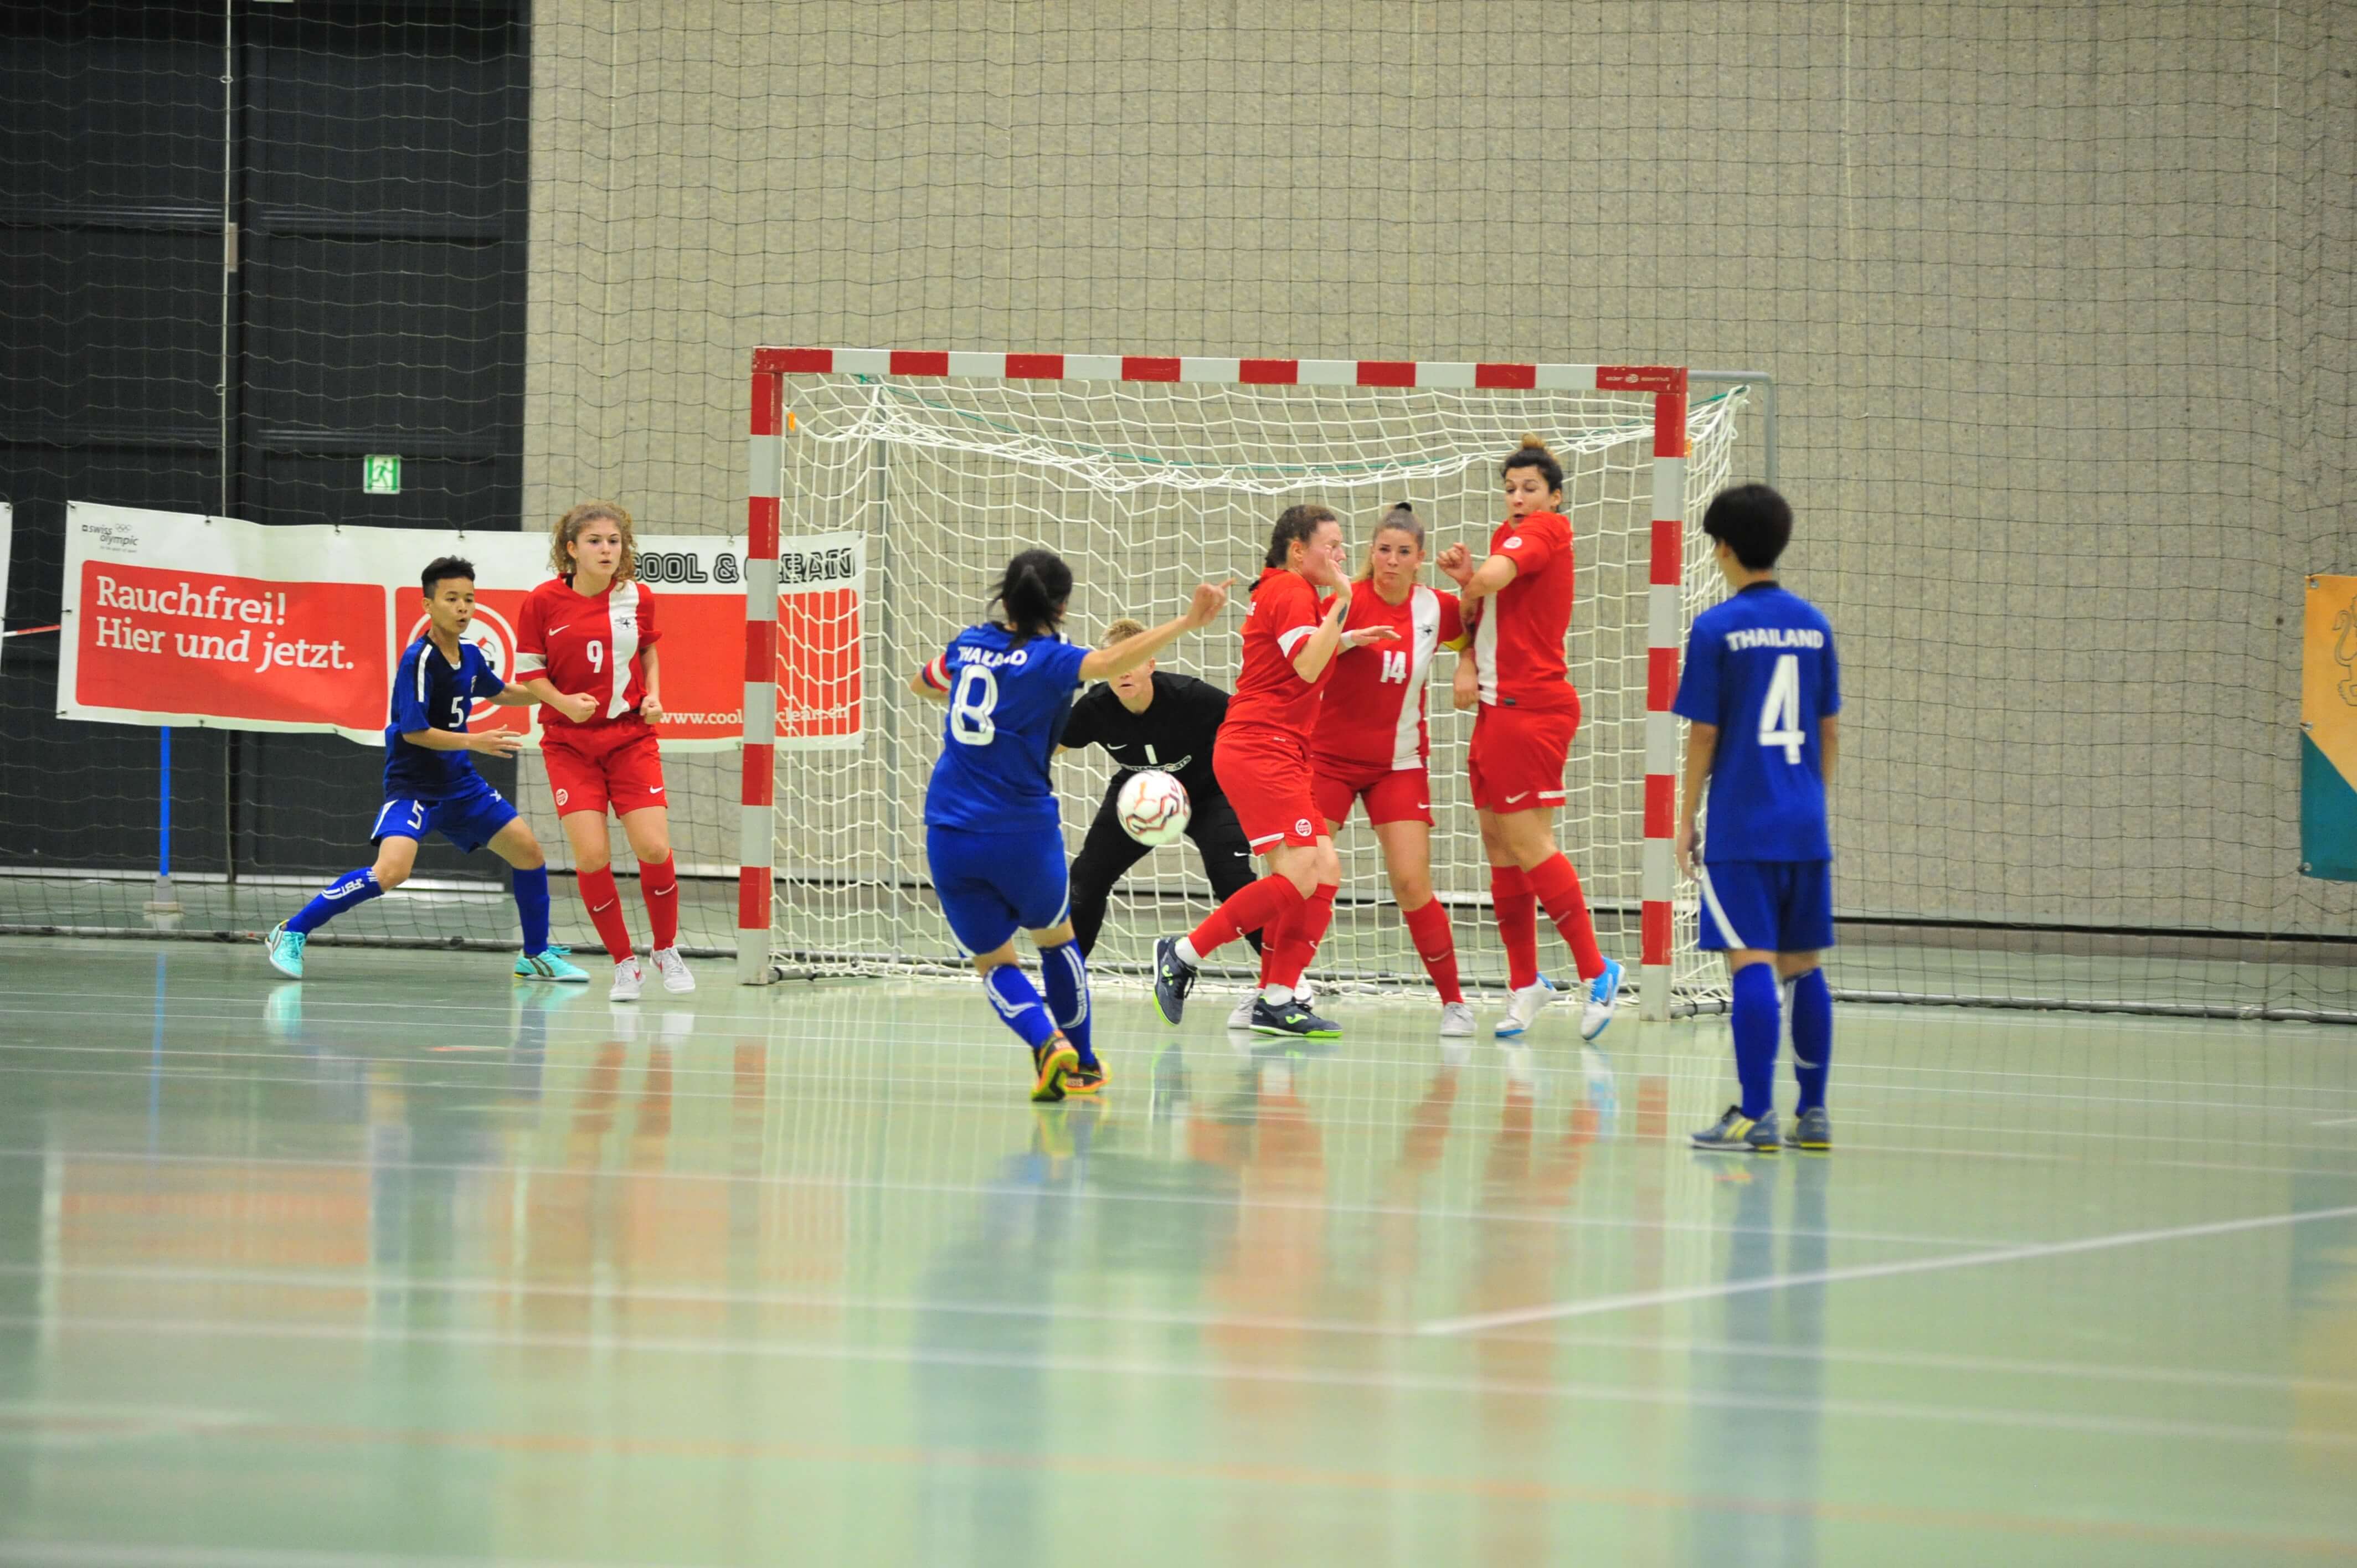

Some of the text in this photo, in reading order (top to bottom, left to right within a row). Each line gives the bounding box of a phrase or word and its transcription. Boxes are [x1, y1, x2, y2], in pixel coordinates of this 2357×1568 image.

[89, 524, 112, 535] swiss
[100, 535, 138, 546] olympic
[713, 553, 739, 584] &
[96, 575, 286, 626] Rauchfrei!
[96, 616, 354, 673] Hier und jetzt.
[1726, 628, 1824, 651] THAILAND
[586, 640, 603, 673] 9
[1380, 650, 1407, 684] 14
[448, 696, 464, 728] 5
[950, 664, 998, 745] 8
[1758, 654, 1805, 765] 4
[406, 800, 425, 830] 5
